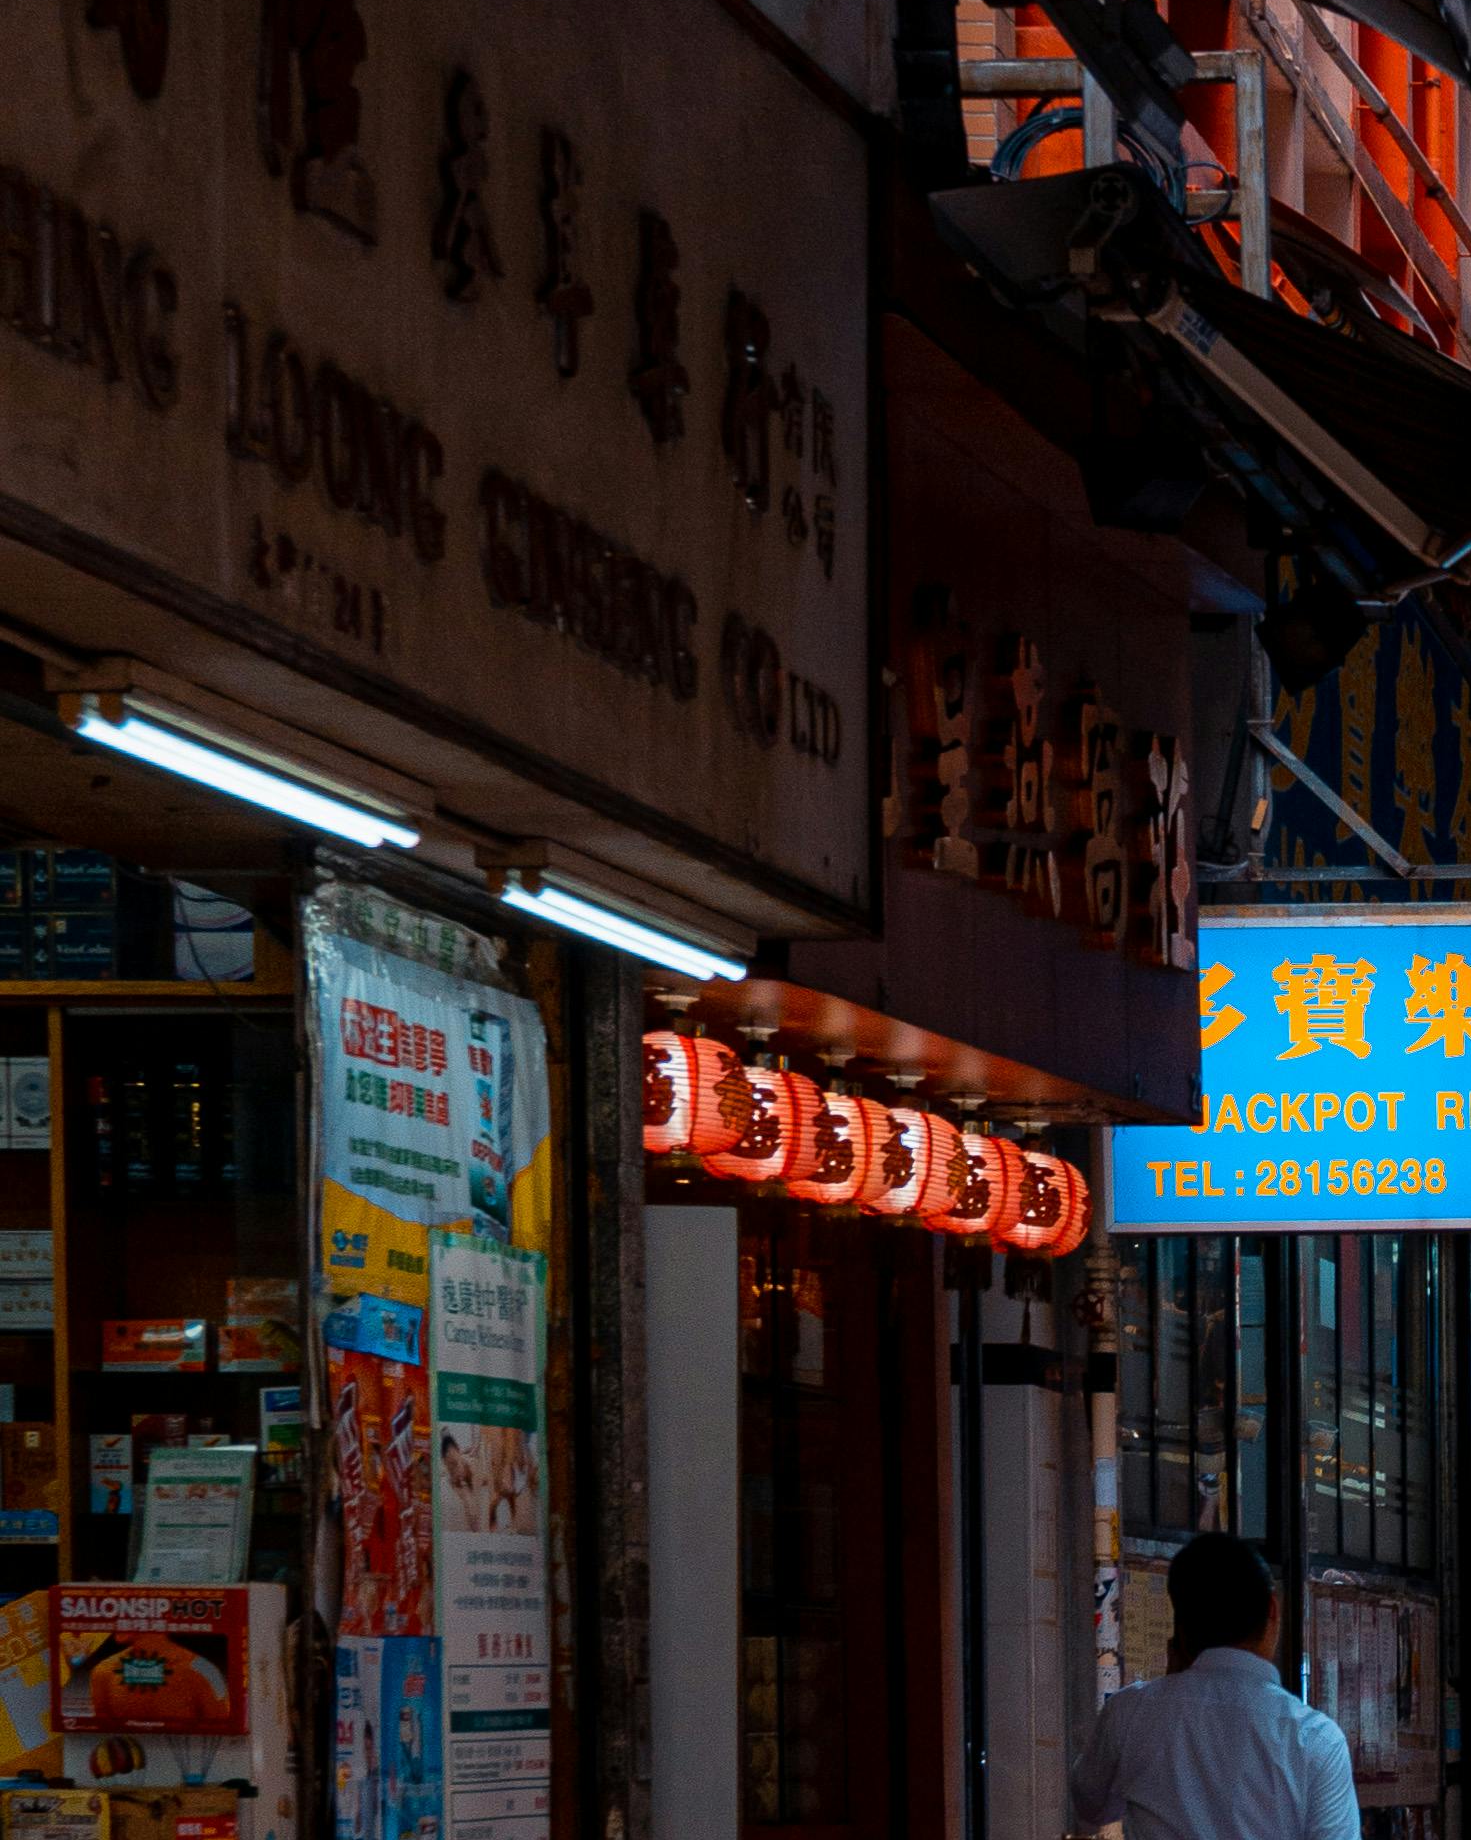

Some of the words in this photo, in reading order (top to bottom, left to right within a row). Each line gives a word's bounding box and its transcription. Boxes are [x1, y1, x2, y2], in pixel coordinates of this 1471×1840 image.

[790, 669, 840, 763] LTD
[1190, 1090, 1405, 1135] JACKPOT
[1256, 1158, 1448, 1197] 28156238
[60, 1597, 170, 1620] SALONSIP
[172, 1599, 226, 1620] HOT
